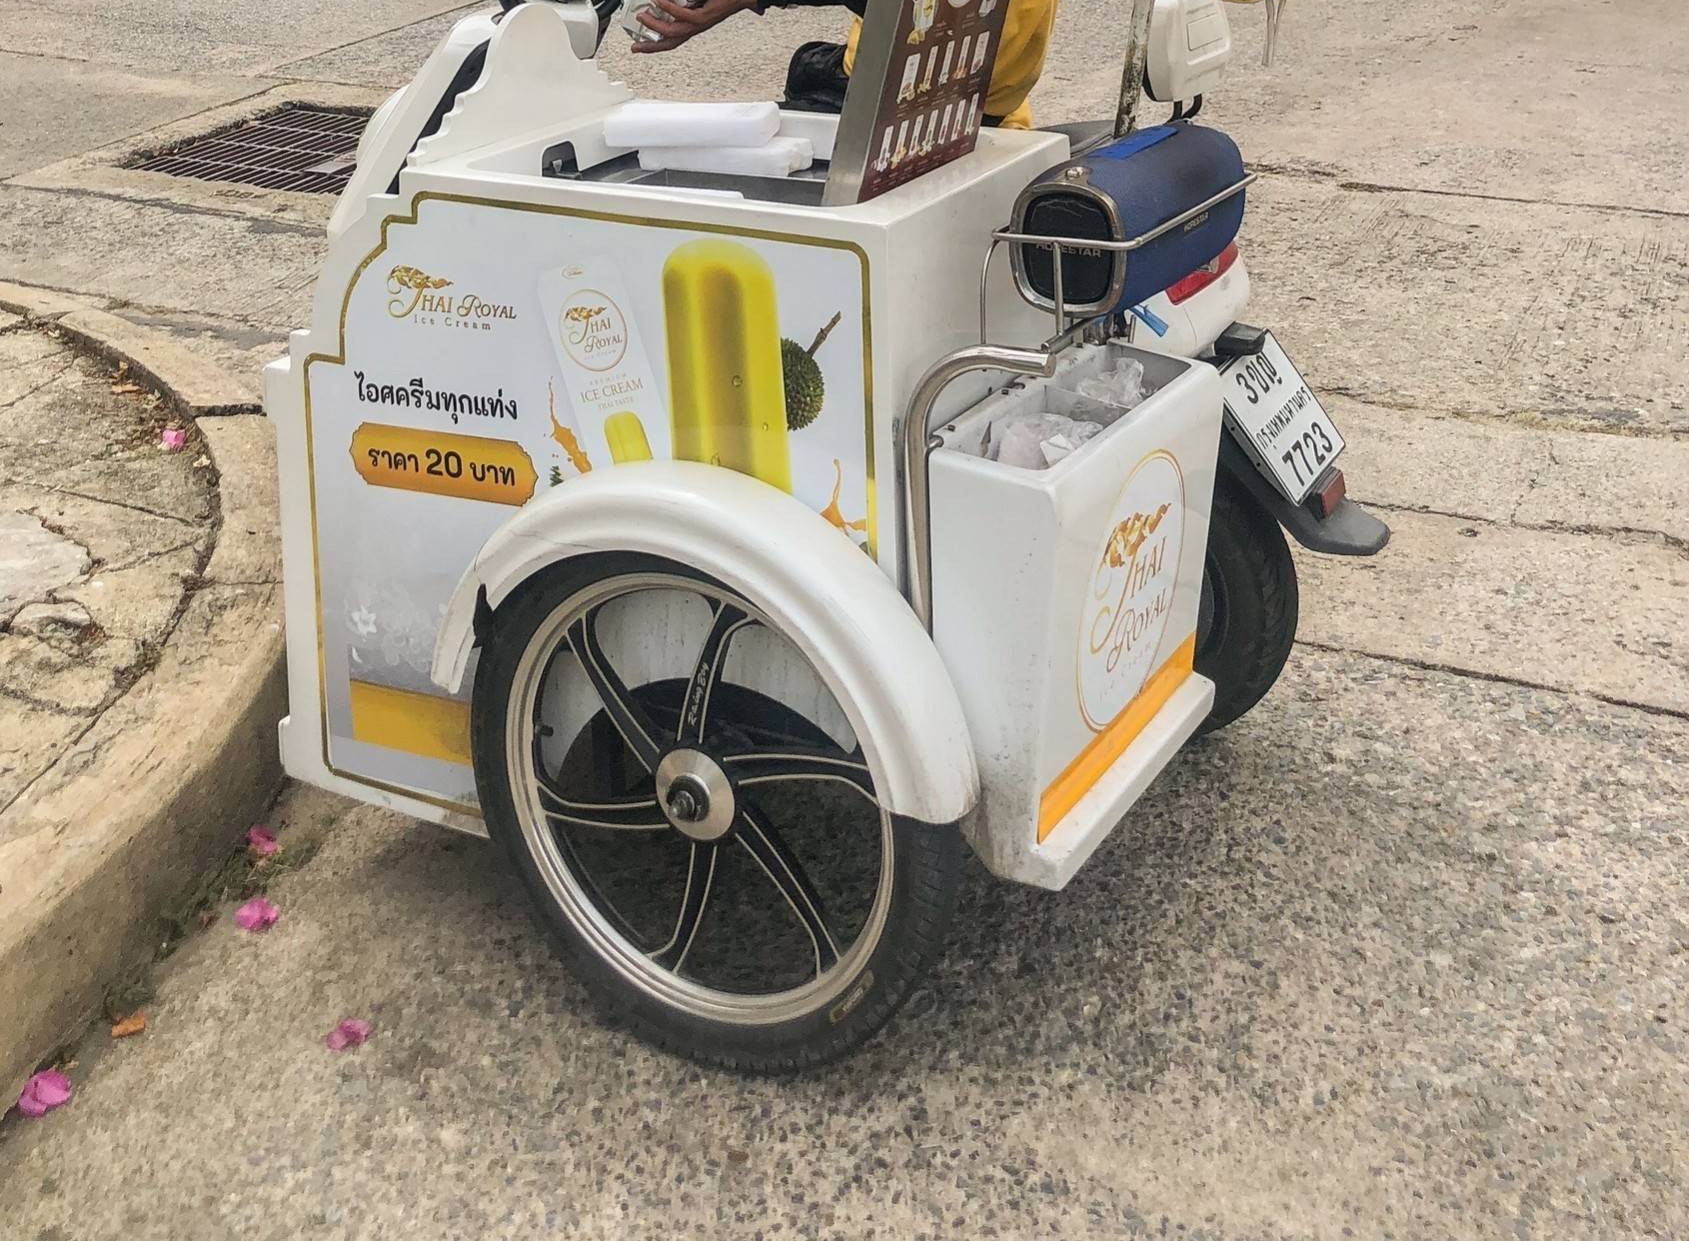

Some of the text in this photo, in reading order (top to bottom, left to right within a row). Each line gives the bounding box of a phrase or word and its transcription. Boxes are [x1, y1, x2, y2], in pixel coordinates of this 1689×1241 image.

[386, 264, 517, 319] THAI ROYAL
[413, 314, 491, 331] Ice Cream
[584, 334, 623, 353] ROYAL
[354, 370, 518, 425] ไอศครีมทุกแท่ง
[580, 378, 644, 403] ICE CREAM
[1255, 386, 1312, 450] กรุงเทพมหานคร
[368, 447, 516, 486] ราคา 20 บาท
[1281, 421, 1333, 487] 7723
[1106, 587, 1167, 673] ROYAL
